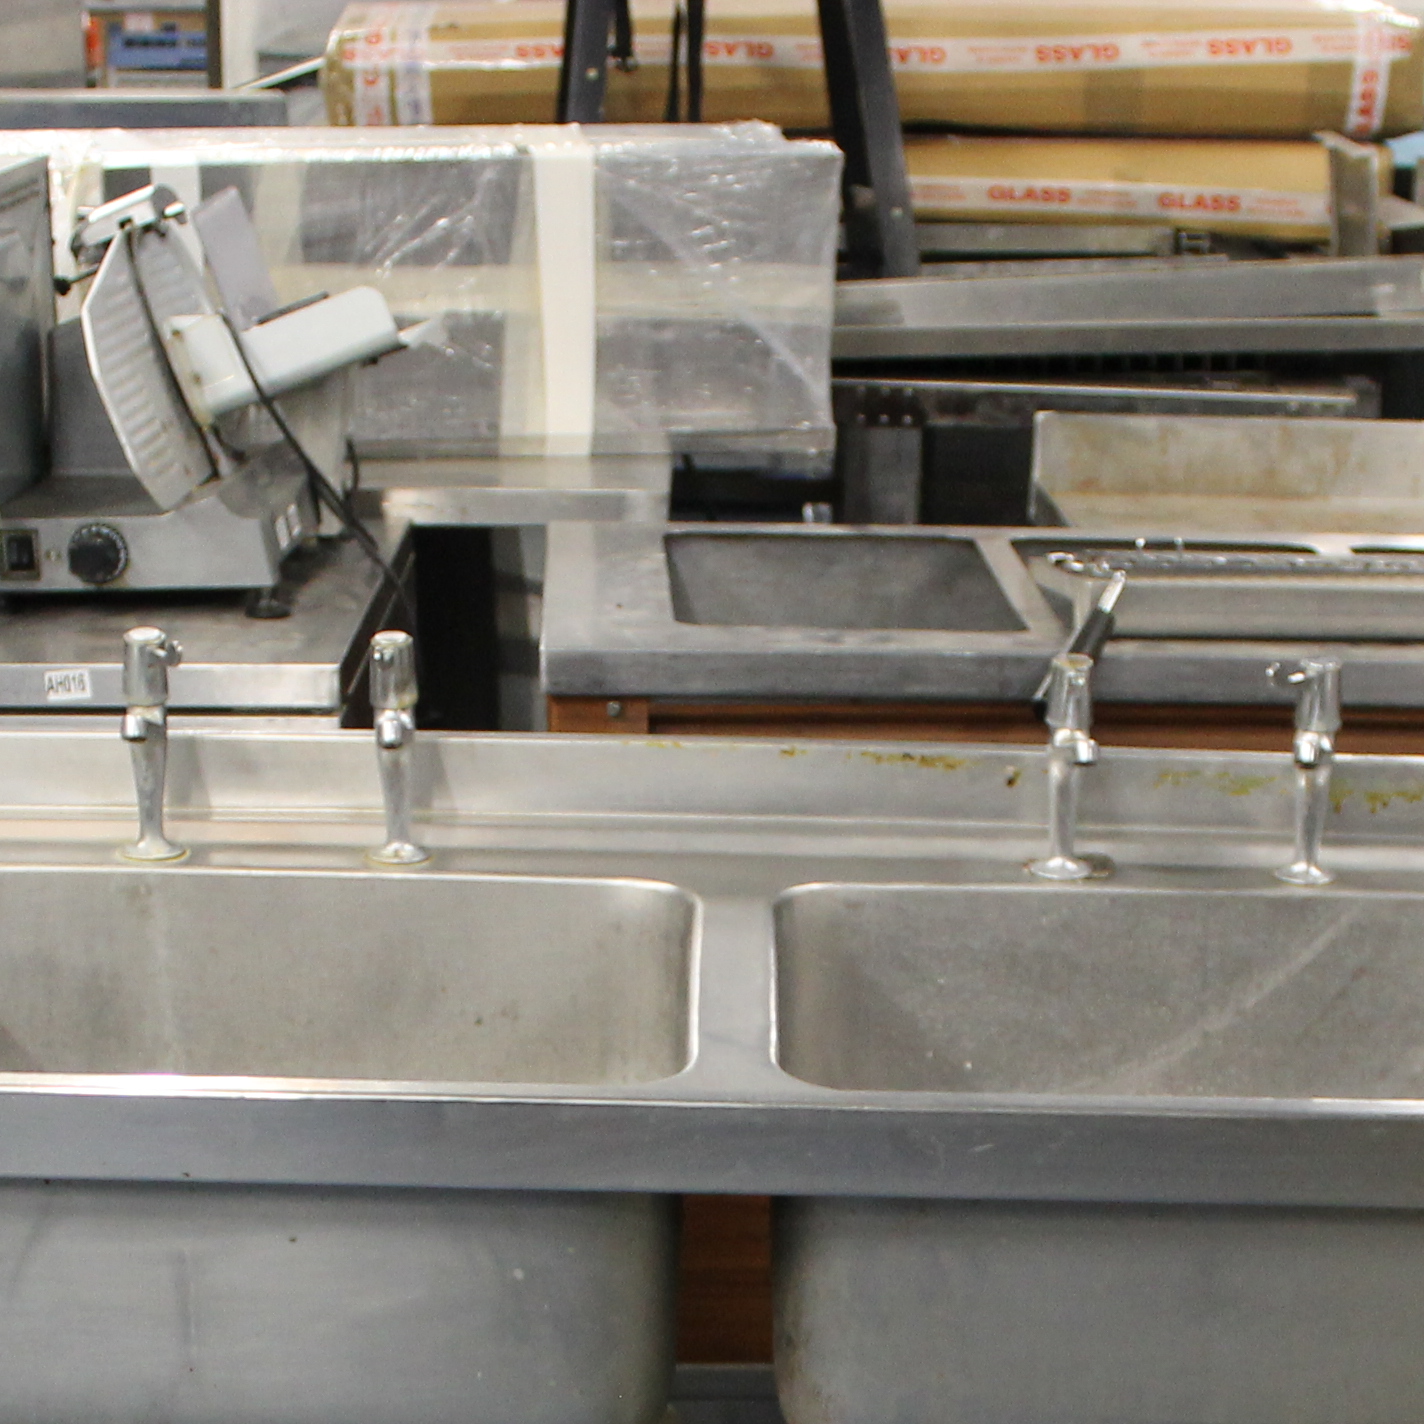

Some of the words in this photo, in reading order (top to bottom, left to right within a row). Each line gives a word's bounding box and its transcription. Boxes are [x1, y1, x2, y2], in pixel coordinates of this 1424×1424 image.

[1035, 43, 1121, 63] GLASS
[1207, 37, 1293, 57] GLASS
[987, 184, 1072, 204] GLASS
[1157, 192, 1242, 213] GLASS
